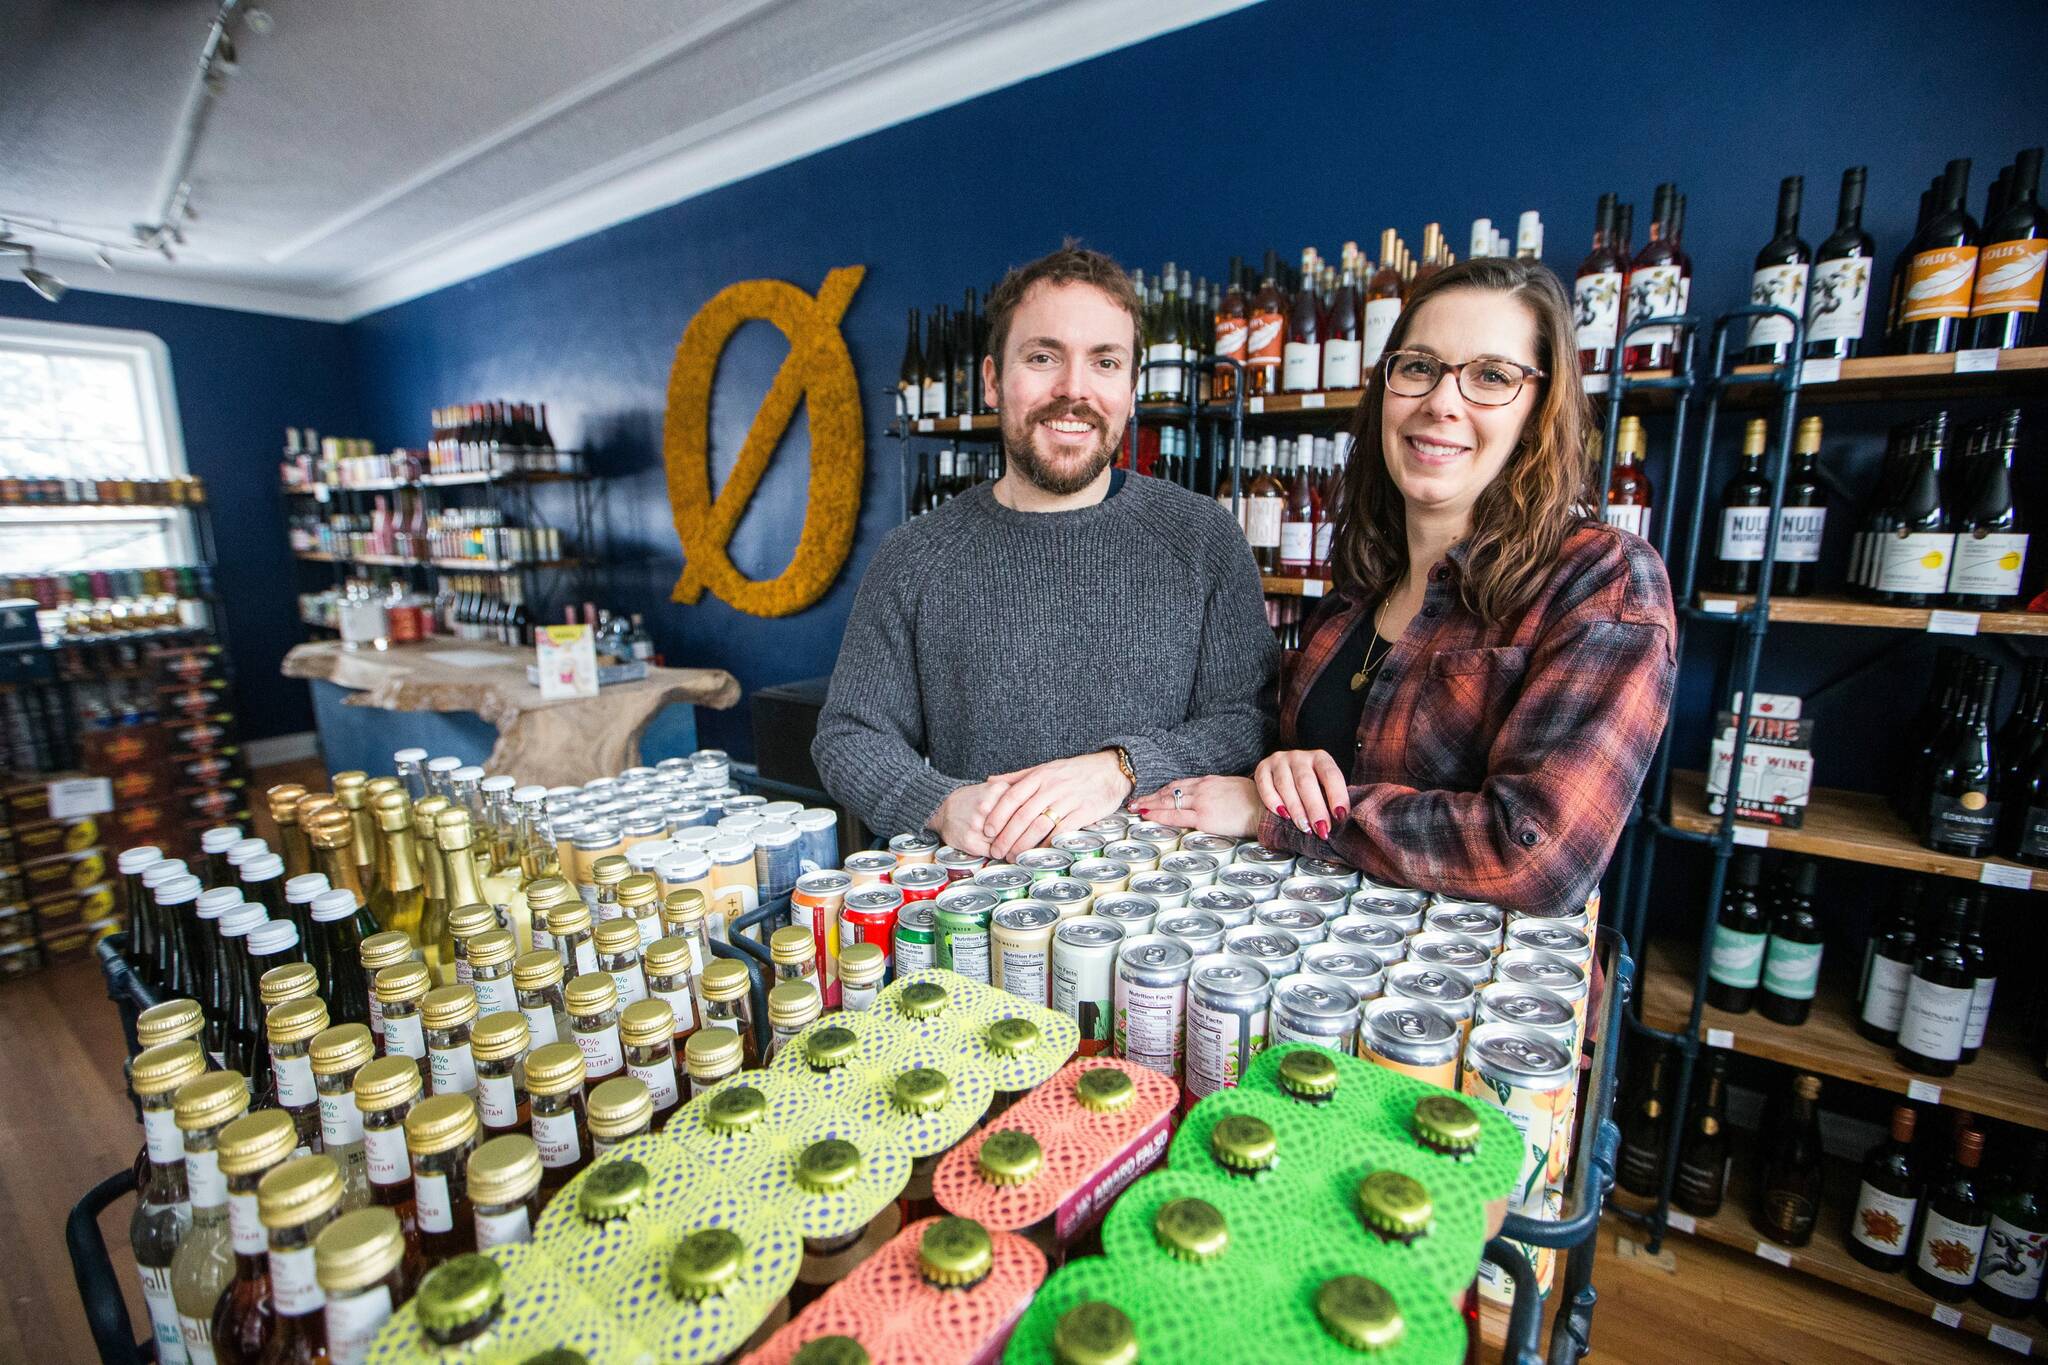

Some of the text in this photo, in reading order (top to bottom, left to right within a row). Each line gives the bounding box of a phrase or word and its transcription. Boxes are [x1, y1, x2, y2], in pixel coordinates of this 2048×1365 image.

[1733, 515, 1769, 532] NUL
[1783, 515, 1822, 532] NULL
[1719, 752, 1758, 767] WNE
[1767, 755, 1808, 772] WINE
[1762, 801, 1797, 815] WINE
[1003, 951, 1028, 959] Nutrition
[1062, 967, 1077, 977] Facts
[1128, 989, 1173, 1001] Nutrition Facts
[1205, 1013, 1223, 1025] Facts
[387, 1045, 405, 1053] ONIC
[586, 1056, 614, 1068] OLITAN
[650, 1087, 671, 1099] NGER
[1506, 1109, 1530, 1121] Facts
[1093, 1156, 1136, 1203] AMARO
[1136, 1128, 1169, 1168] FALSO
